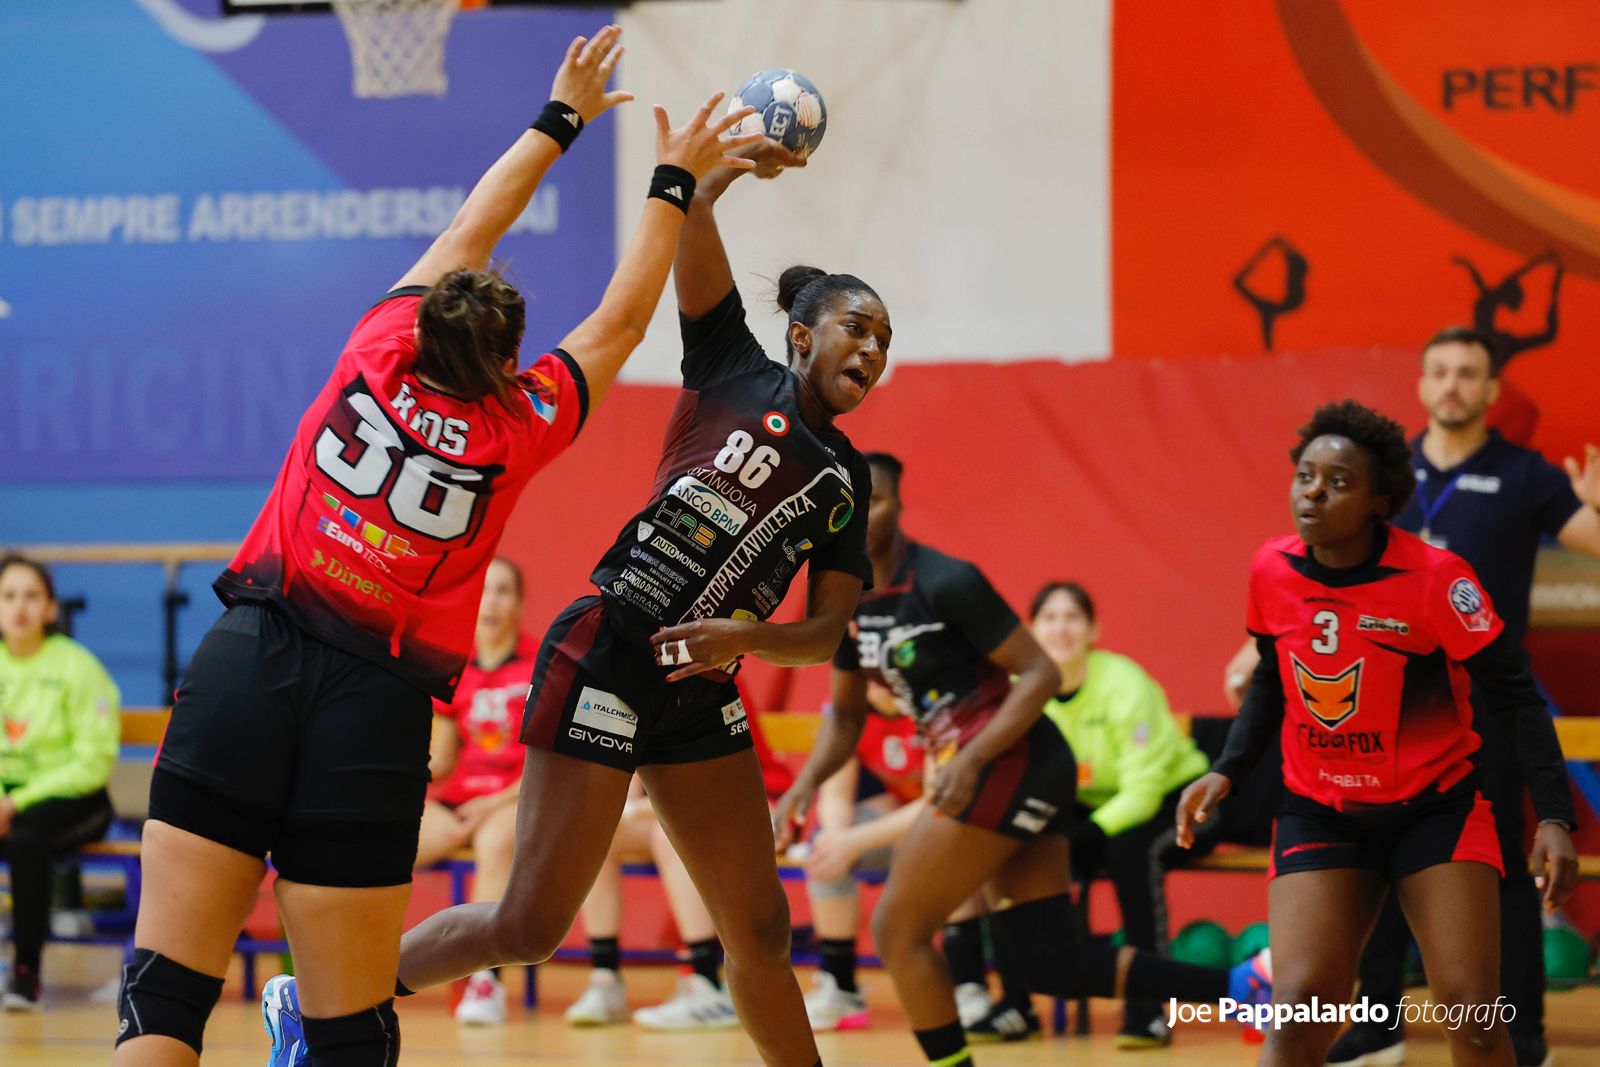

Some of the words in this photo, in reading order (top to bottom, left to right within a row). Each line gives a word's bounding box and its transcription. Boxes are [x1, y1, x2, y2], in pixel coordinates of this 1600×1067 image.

[12, 194, 182, 246] SEMPRE
[390, 382, 470, 457] RIOS
[315, 391, 485, 541] 36
[713, 429, 781, 490] 86
[655, 500, 717, 549] HAB
[710, 508, 740, 535] BPM
[650, 535, 706, 578] AUTOMONDO
[691, 493, 817, 621] #STOPALLAVIOLENZA
[625, 586, 663, 614] FERRARI
[1311, 610, 1340, 655] 3
[593, 703, 637, 723] ITALCHIMICA
[568, 727, 633, 754] GIVOVA
